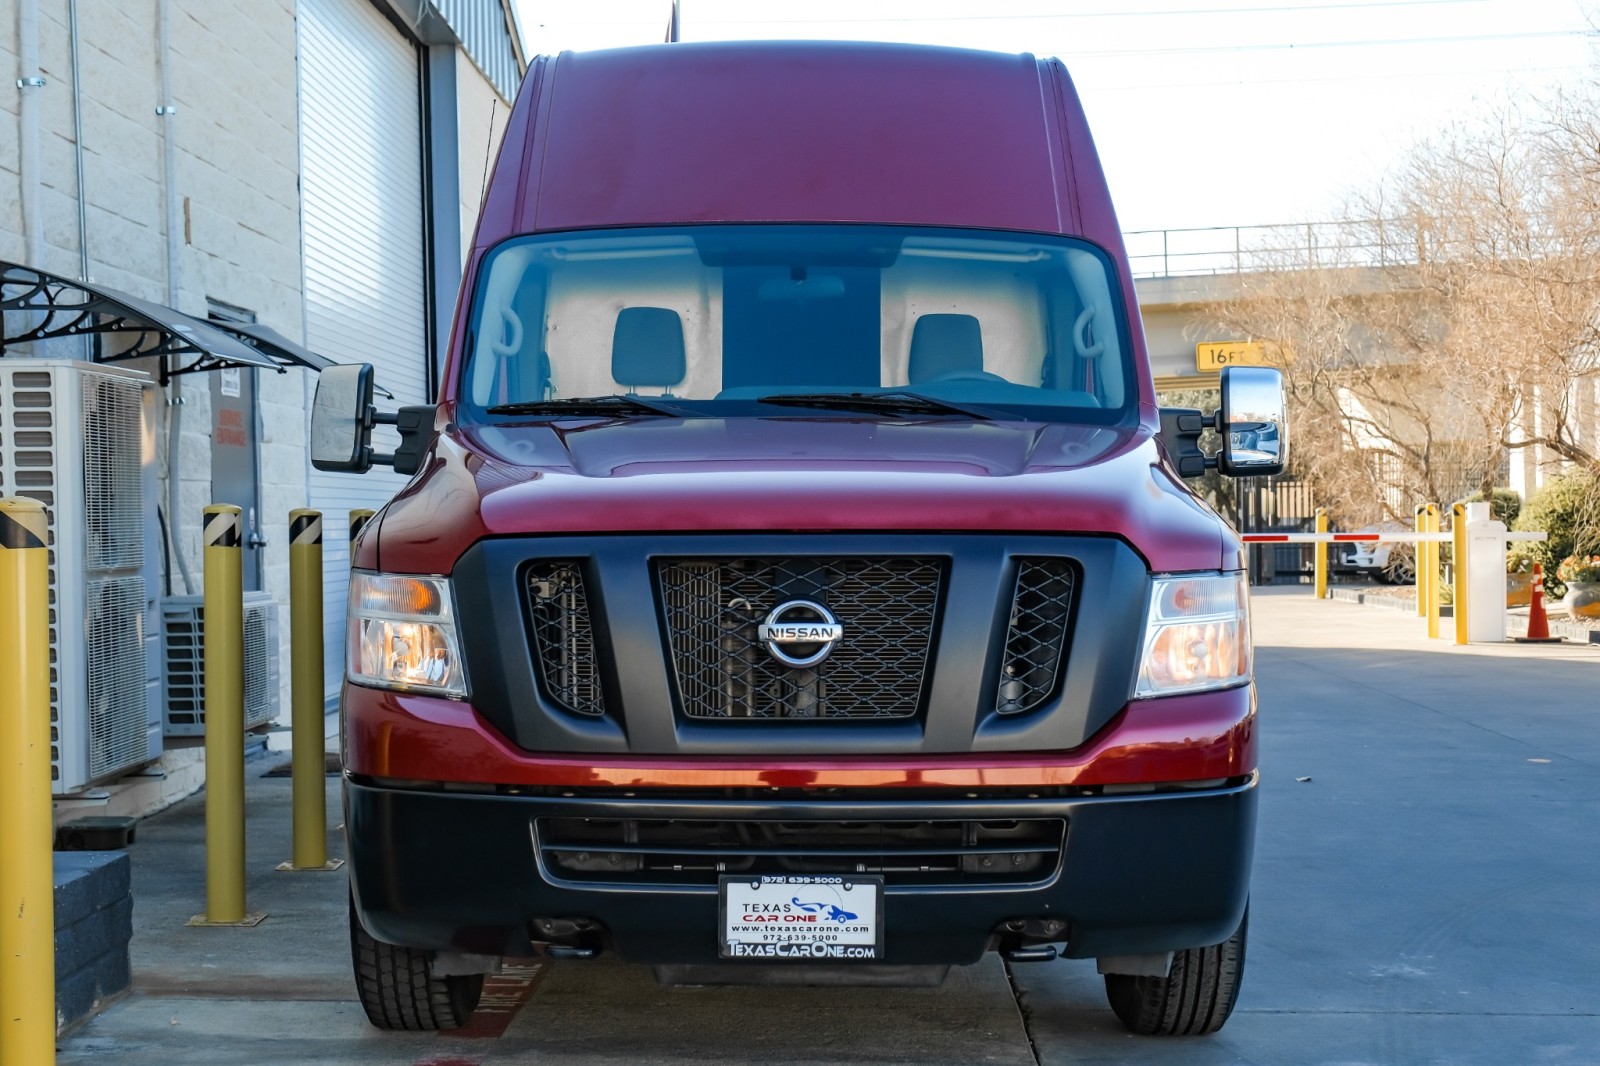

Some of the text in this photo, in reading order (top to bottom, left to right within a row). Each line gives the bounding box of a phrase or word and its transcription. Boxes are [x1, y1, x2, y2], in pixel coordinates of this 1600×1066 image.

[767, 627, 833, 638] NISSAN
[761, 875, 843, 884] (972) 639-5000
[742, 903, 791, 913] TEXAS
[742, 914, 817, 923] CAR ONE
